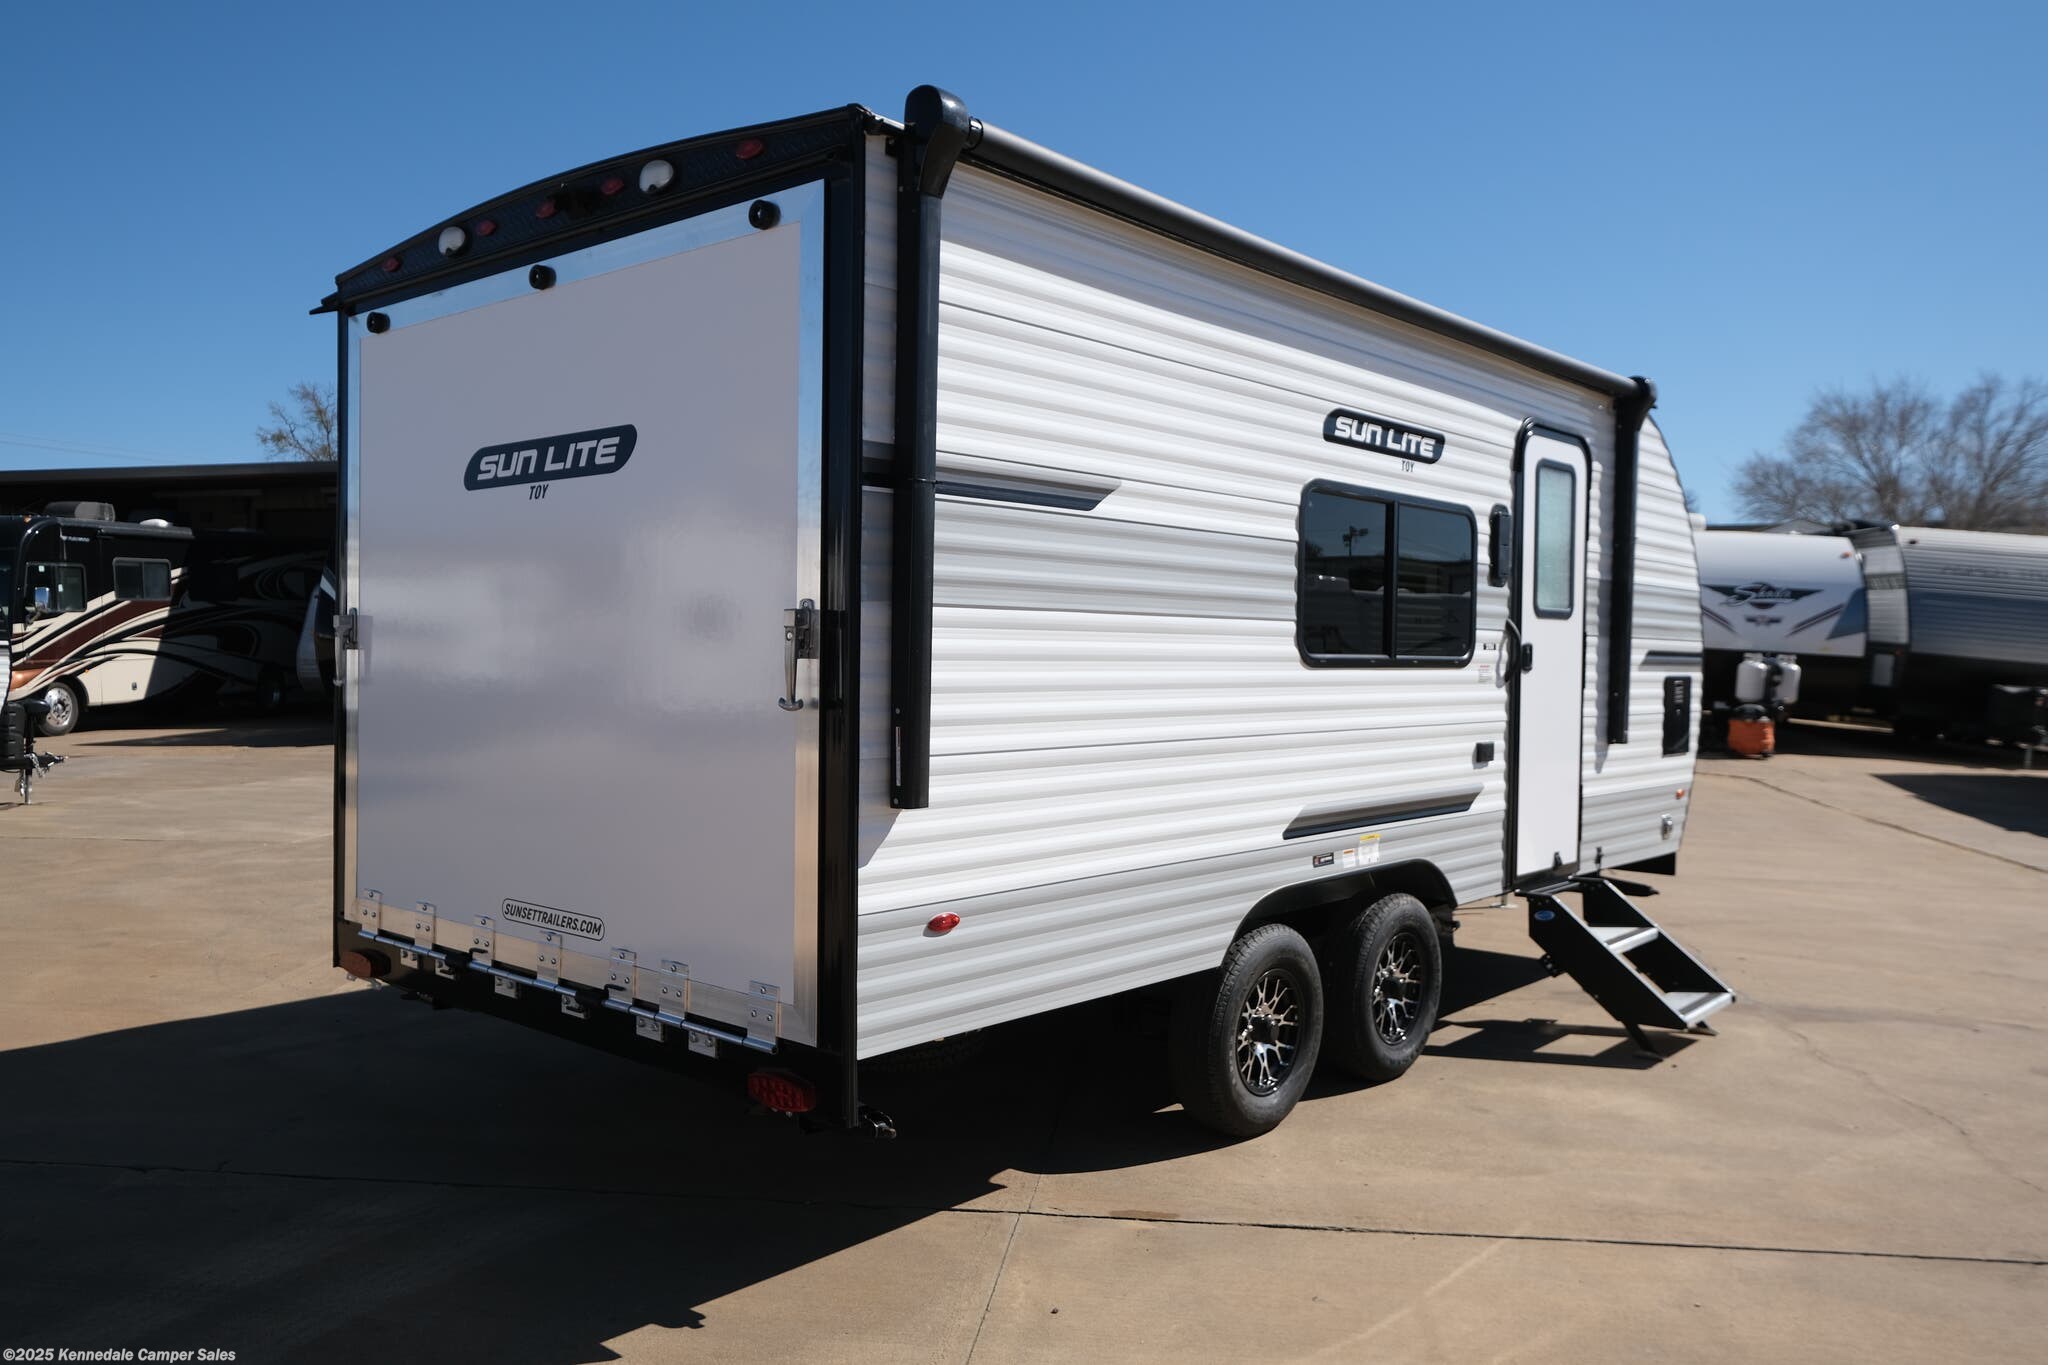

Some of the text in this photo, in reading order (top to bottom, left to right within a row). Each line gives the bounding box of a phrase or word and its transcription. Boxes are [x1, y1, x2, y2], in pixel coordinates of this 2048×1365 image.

[1334, 416, 1437, 459] SUN LITE
[477, 436, 620, 481] SUN LITE
[1401, 460, 1415, 473] TOY
[529, 483, 549, 500] TOY
[504, 903, 602, 936] SUNSETTRAILERS.COM
